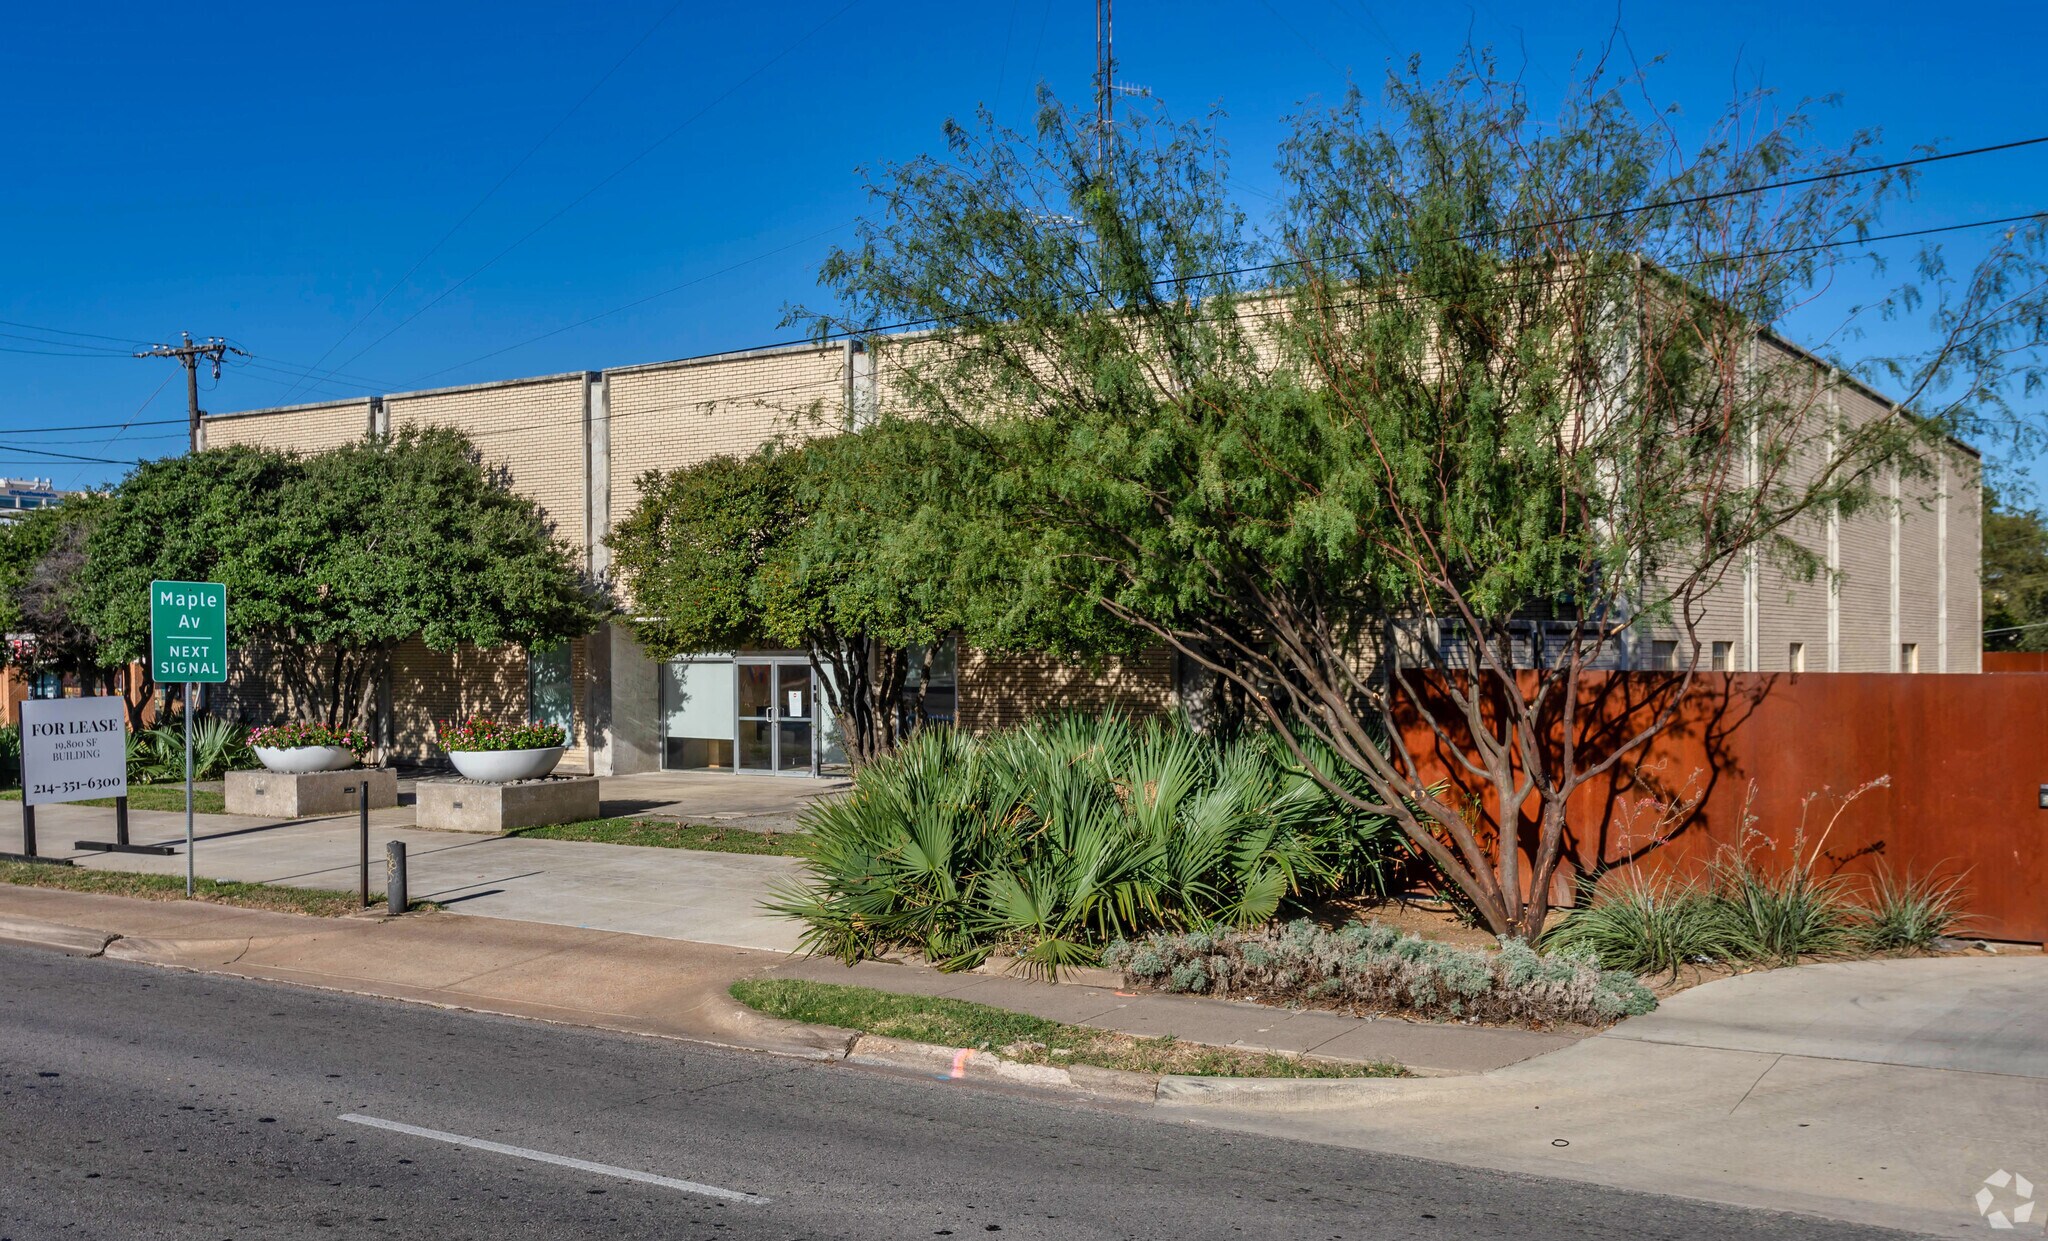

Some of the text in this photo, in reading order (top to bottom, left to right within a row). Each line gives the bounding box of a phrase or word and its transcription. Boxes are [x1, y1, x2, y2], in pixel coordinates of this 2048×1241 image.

[160, 591, 217, 611] Maple
[178, 614, 200, 629] Av
[169, 645, 209, 658] NEXT
[160, 661, 219, 674] SIGNAL
[31, 718, 118, 737] FOR LEASE
[55, 738, 98, 750] 19,800 SF
[52, 749, 100, 762] BUILDING
[33, 776, 121, 795] 214-351-6300
